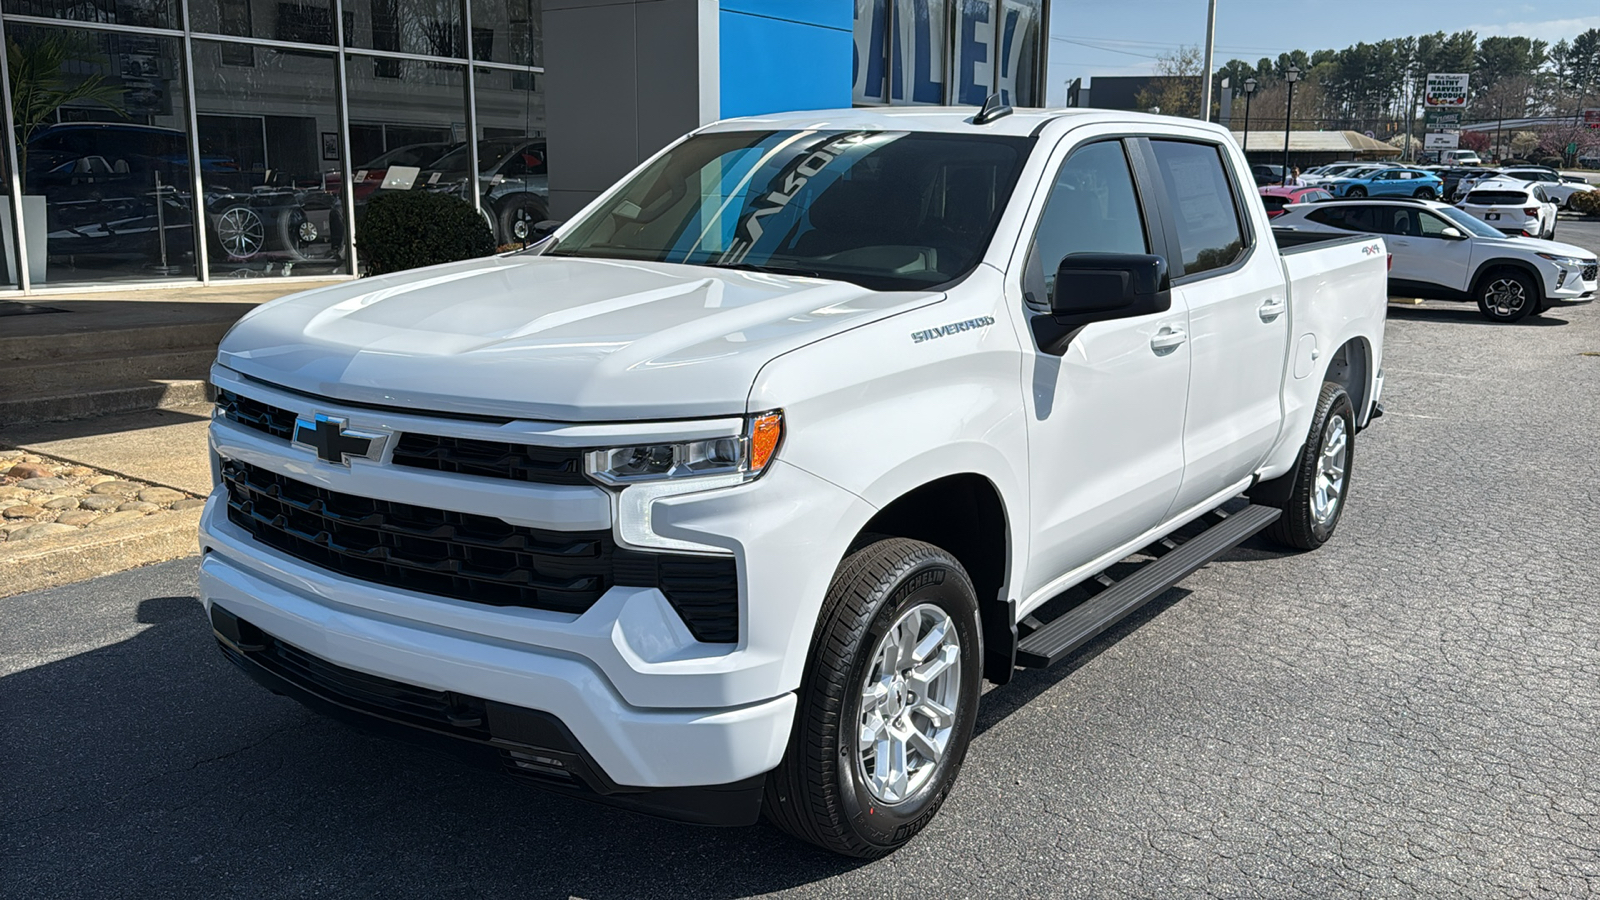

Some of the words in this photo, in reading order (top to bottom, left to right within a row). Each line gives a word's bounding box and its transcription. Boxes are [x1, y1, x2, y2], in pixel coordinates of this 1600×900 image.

[852, 0, 1020, 106] ALE!
[910, 315, 996, 344] SILVERADO
[894, 569, 945, 606] MICHELIN
